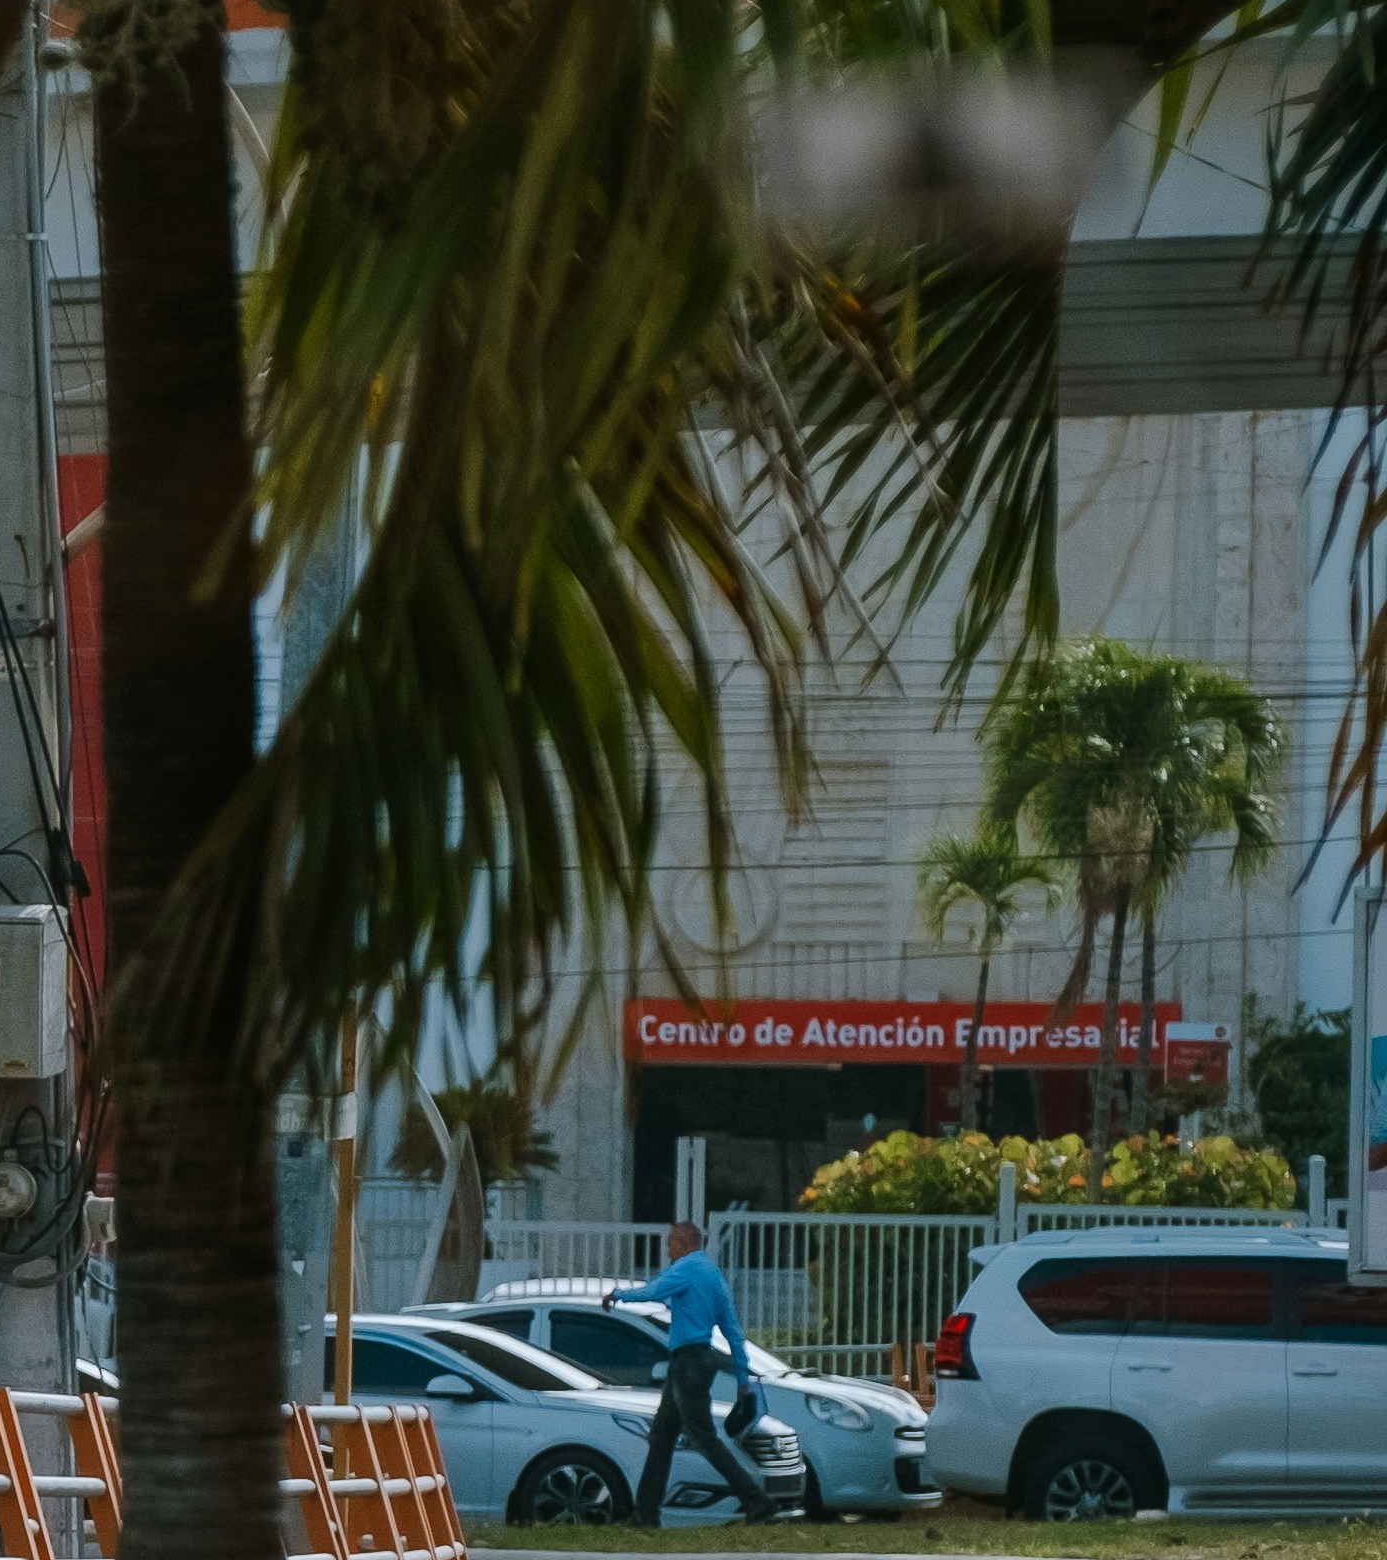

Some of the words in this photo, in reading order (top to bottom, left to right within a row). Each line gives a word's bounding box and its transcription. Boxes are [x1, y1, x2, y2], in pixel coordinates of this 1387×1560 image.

[638, 1014, 746, 1046] Centro
[753, 1016, 794, 1046] de
[801, 1015, 945, 1048] Atención
